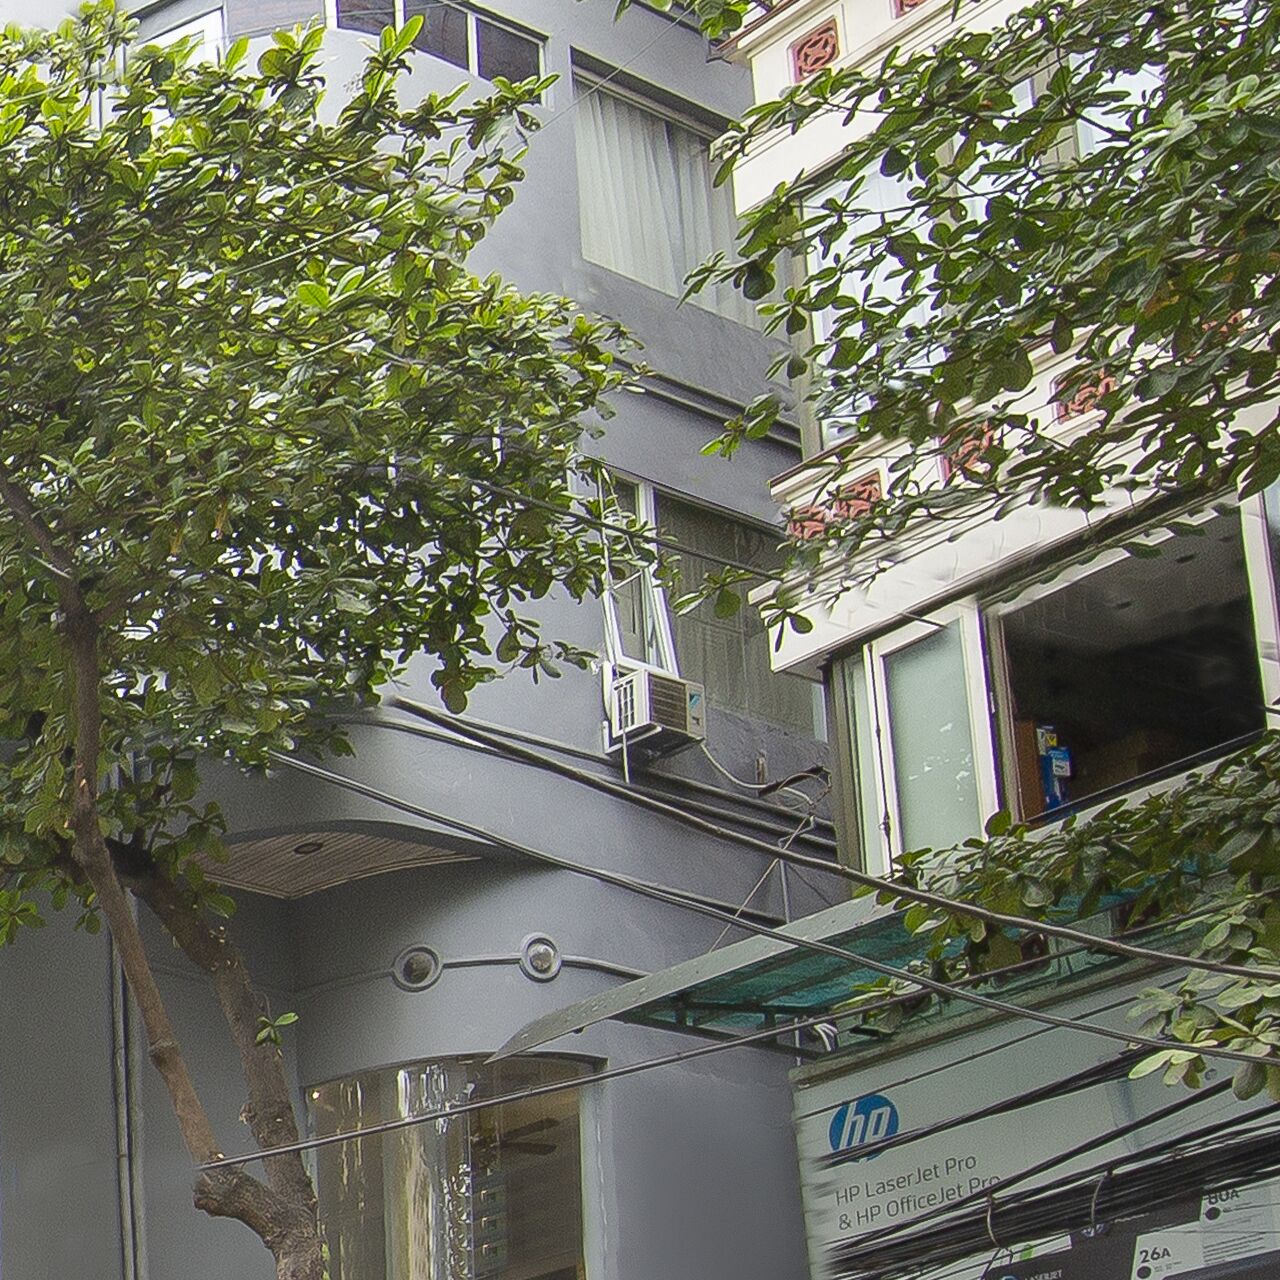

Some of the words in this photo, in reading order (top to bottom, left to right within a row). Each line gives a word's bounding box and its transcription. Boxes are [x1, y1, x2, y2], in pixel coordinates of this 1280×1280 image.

[835, 1184, 861, 1207] HP
[865, 1163, 940, 1198] LaserJet
[945, 1155, 977, 1176] Pro
[838, 1214, 852, 1231] &
[856, 1205, 881, 1226] HP
[886, 1184, 963, 1217] OfficeJet
[969, 1175, 1001, 1195] Pro
[1139, 1247, 1172, 1264] 26A
